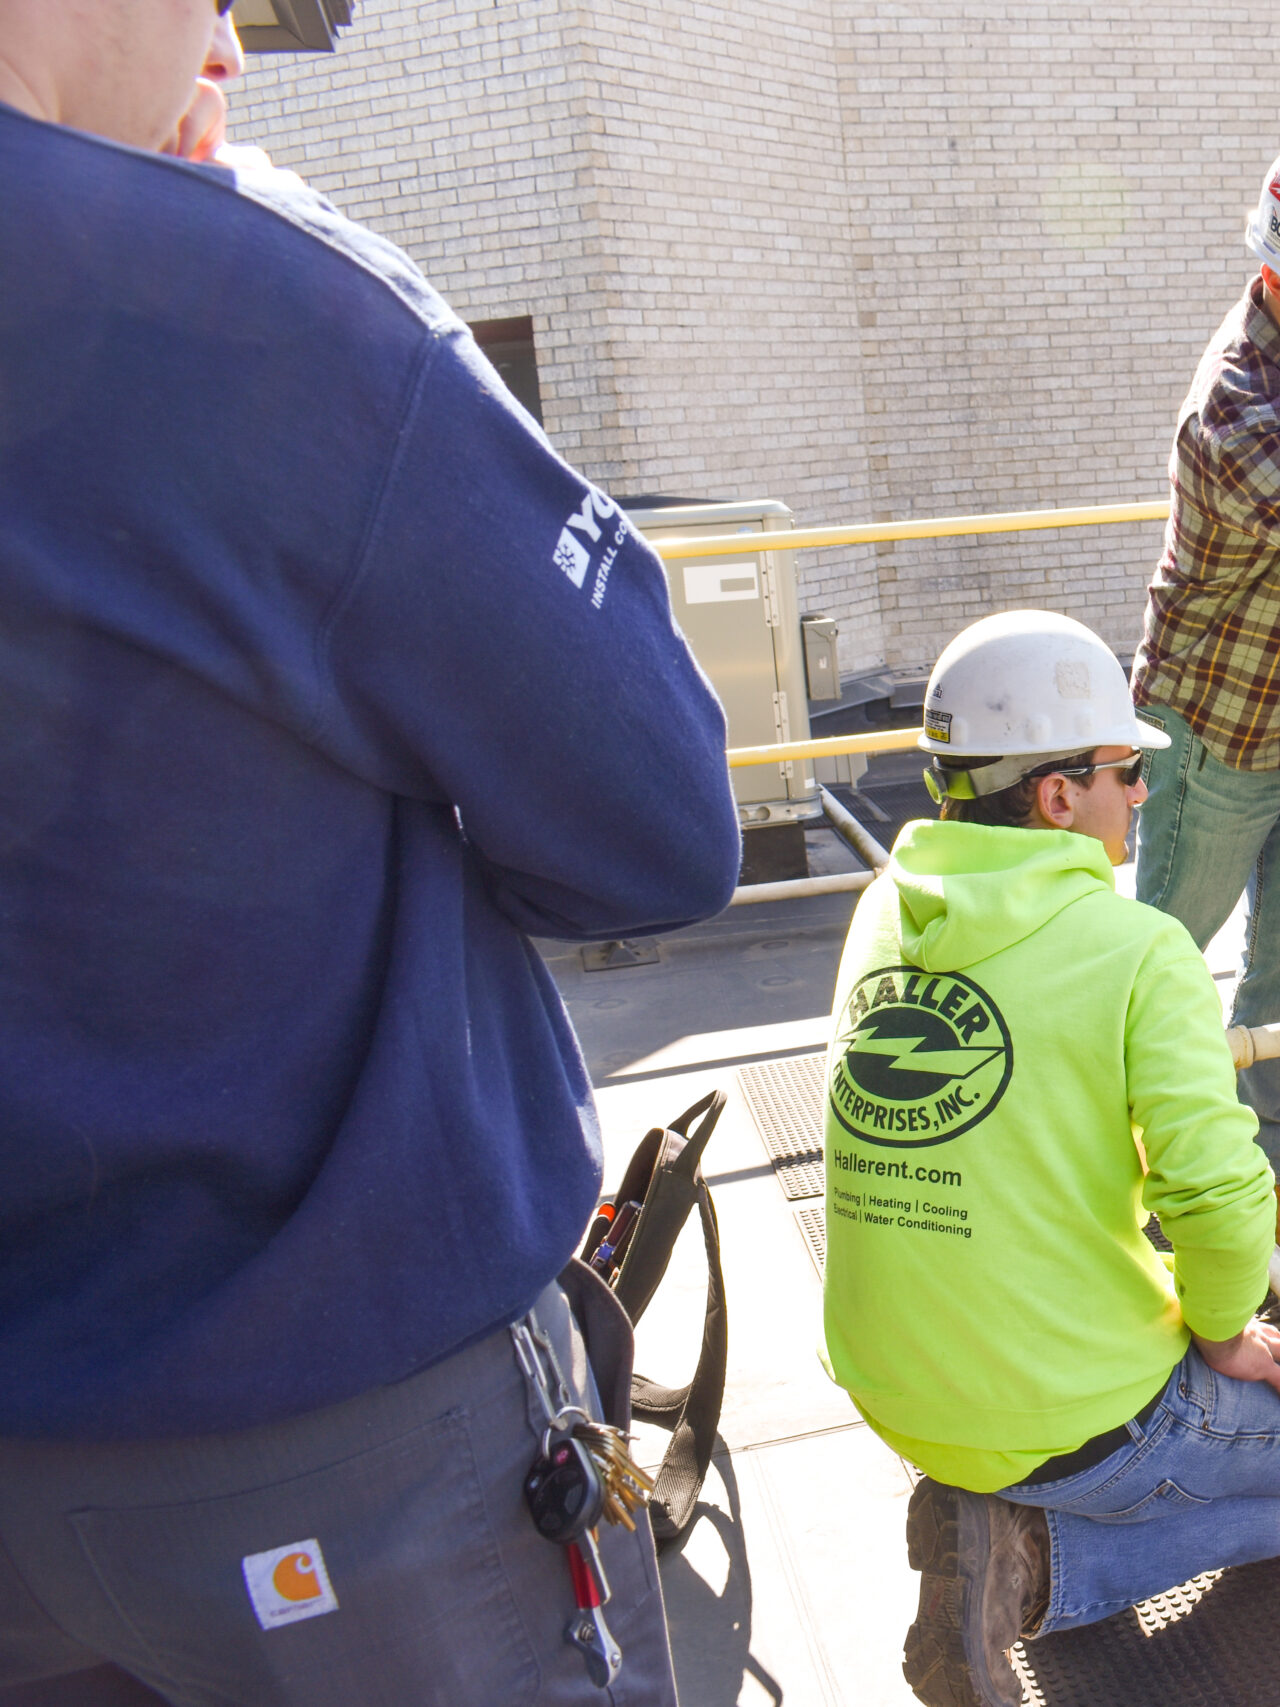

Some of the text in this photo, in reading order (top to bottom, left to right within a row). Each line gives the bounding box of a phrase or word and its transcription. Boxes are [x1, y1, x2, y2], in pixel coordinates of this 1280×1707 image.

[590, 546, 618, 610] INSTALL
[849, 974, 990, 1045] HALLER
[834, 1149, 962, 1187] Hallerent.com
[864, 1212, 894, 1225] Water
[897, 1216, 972, 1238] Conditioning
[869, 1195, 911, 1213] Heating
[922, 1202, 968, 1220] Cooling
